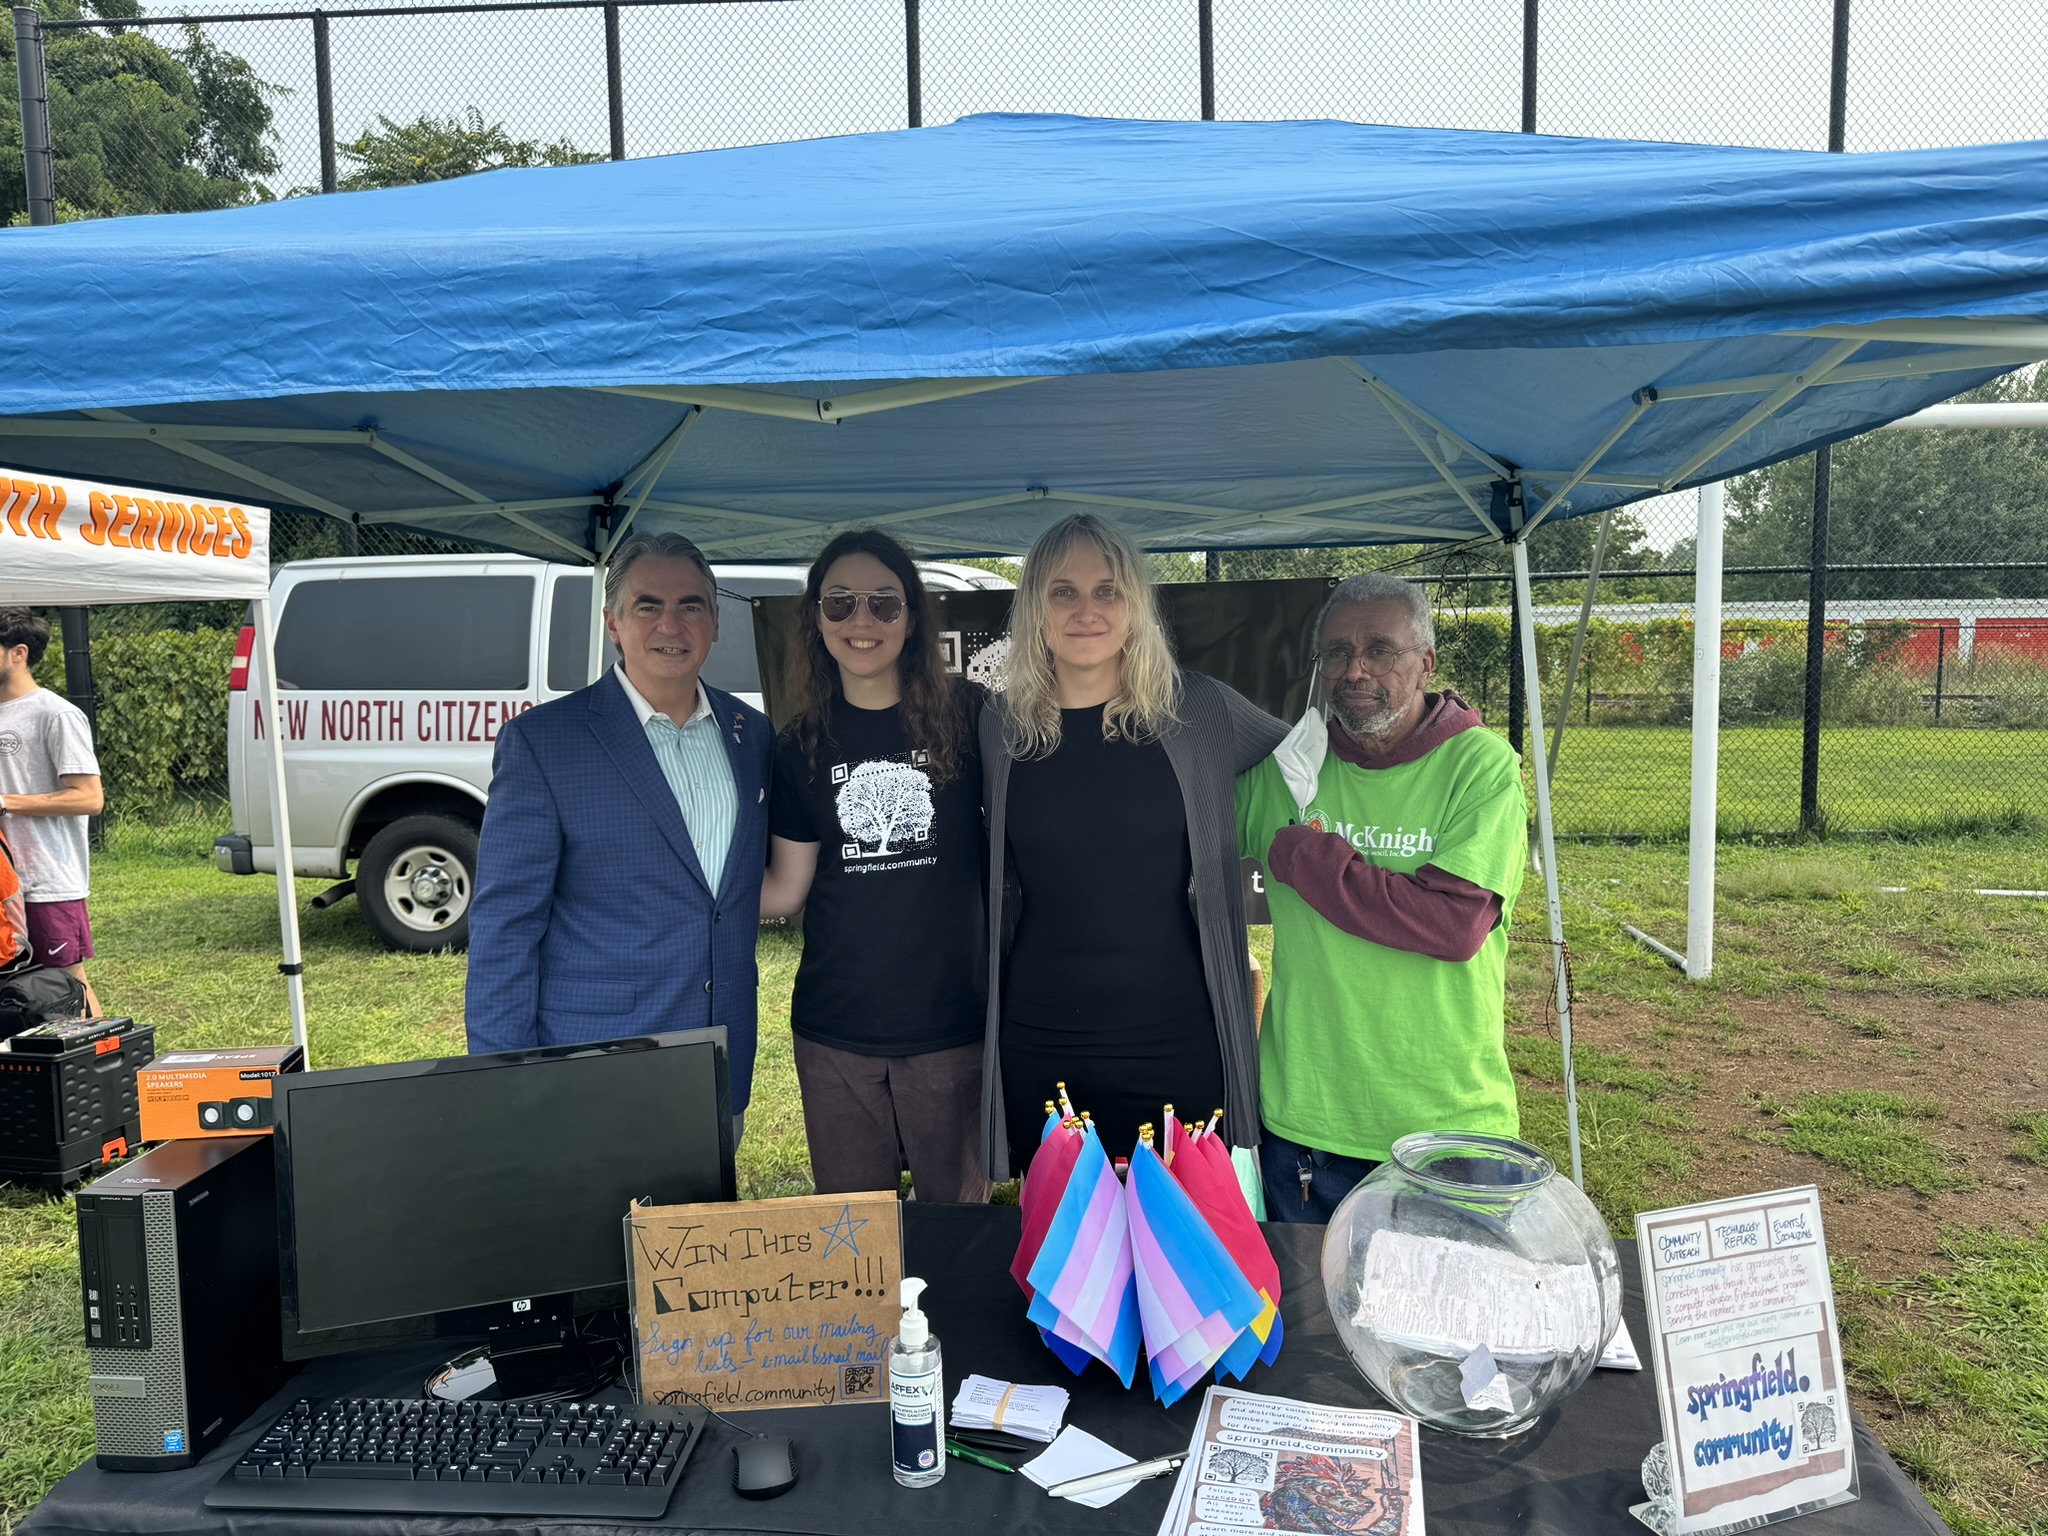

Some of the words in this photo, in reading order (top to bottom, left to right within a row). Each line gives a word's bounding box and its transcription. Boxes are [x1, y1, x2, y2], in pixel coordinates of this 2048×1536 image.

[0, 477, 67, 540] TH
[80, 491, 253, 559] SERVICES
[321, 700, 403, 741] NORTH
[417, 700, 534, 742] CITIZEN
[1335, 821, 1438, 858] McKnigh
[844, 856, 938, 874] springfield.community
[158, 1072, 207, 1080] MULTIMEDIA
[1715, 1221, 1761, 1239] TECHNOLOGY
[1775, 1229, 1812, 1244] SOCIALIZING
[730, 1228, 812, 1260] THIS
[1658, 1231, 1702, 1250] COMMUNITY
[1724, 1234, 1758, 1250] REFURB
[1664, 1249, 1700, 1263] OUTREACH
[1731, 1260, 1743, 1272] has
[1747, 1254, 1785, 1273] opportunities
[1790, 1250, 1800, 1263] for
[1666, 1284, 1699, 1301] connecting
[1702, 1279, 1720, 1298] people
[1723, 1274, 1746, 1291] through
[1749, 1272, 1758, 1285] the
[1778, 1266, 1789, 1279] We
[1792, 1264, 1808, 1276] offer
[1675, 1297, 1704, 1314] computer
[1707, 1291, 1732, 1307] donation
[1783, 1278, 1809, 1295] program
[1667, 1313, 1693, 1327] serving
[1695, 1308, 1707, 1320] the
[1709, 1303, 1736, 1317] members
[1749, 1299, 1761, 1309] our
[639, 1321, 693, 1365] Sign
[705, 1331, 734, 1359] up
[744, 1318, 775, 1356] for
[783, 1326, 813, 1340] our
[819, 1313, 885, 1345] mailing
[762, 1345, 809, 1368] e-mail
[94, 1383, 123, 1393] DELL
[1232, 1399, 1282, 1411] Technology
[1228, 1414, 1270, 1424] members
[1292, 1423, 1354, 1435] organizations
[1341, 1421, 1392, 1431] community
[1226, 1433, 1384, 1458] springfield.community
[1694, 1417, 1793, 1467] community
[1208, 1486, 1234, 1494] Follow
[1205, 1507, 1243, 1516] whenever
[1200, 1525, 1227, 1533] Learn
